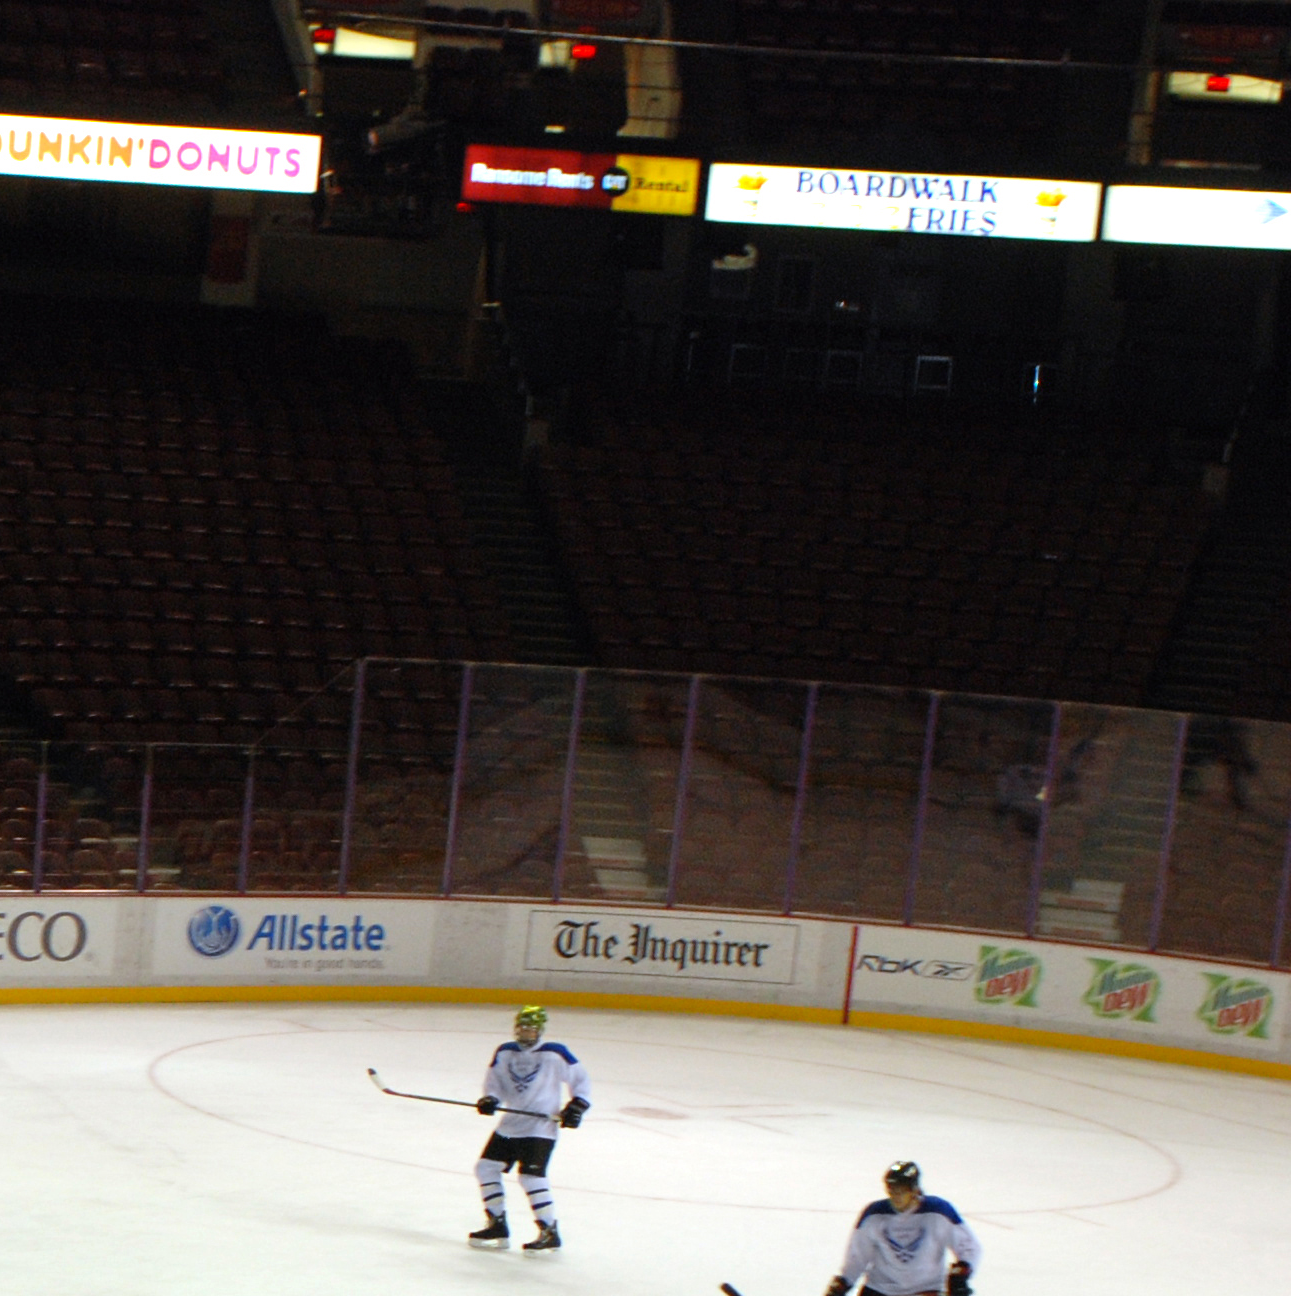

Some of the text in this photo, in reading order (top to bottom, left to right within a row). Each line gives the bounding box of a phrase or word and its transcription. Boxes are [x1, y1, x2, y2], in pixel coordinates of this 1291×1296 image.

[149, 138, 301, 178] DONUTS
[796, 171, 999, 204] BOARDWALK
[907, 207, 998, 235] FRIES
[246, 915, 387, 950] Allstate
[553, 920, 770, 972] The Inquirer
